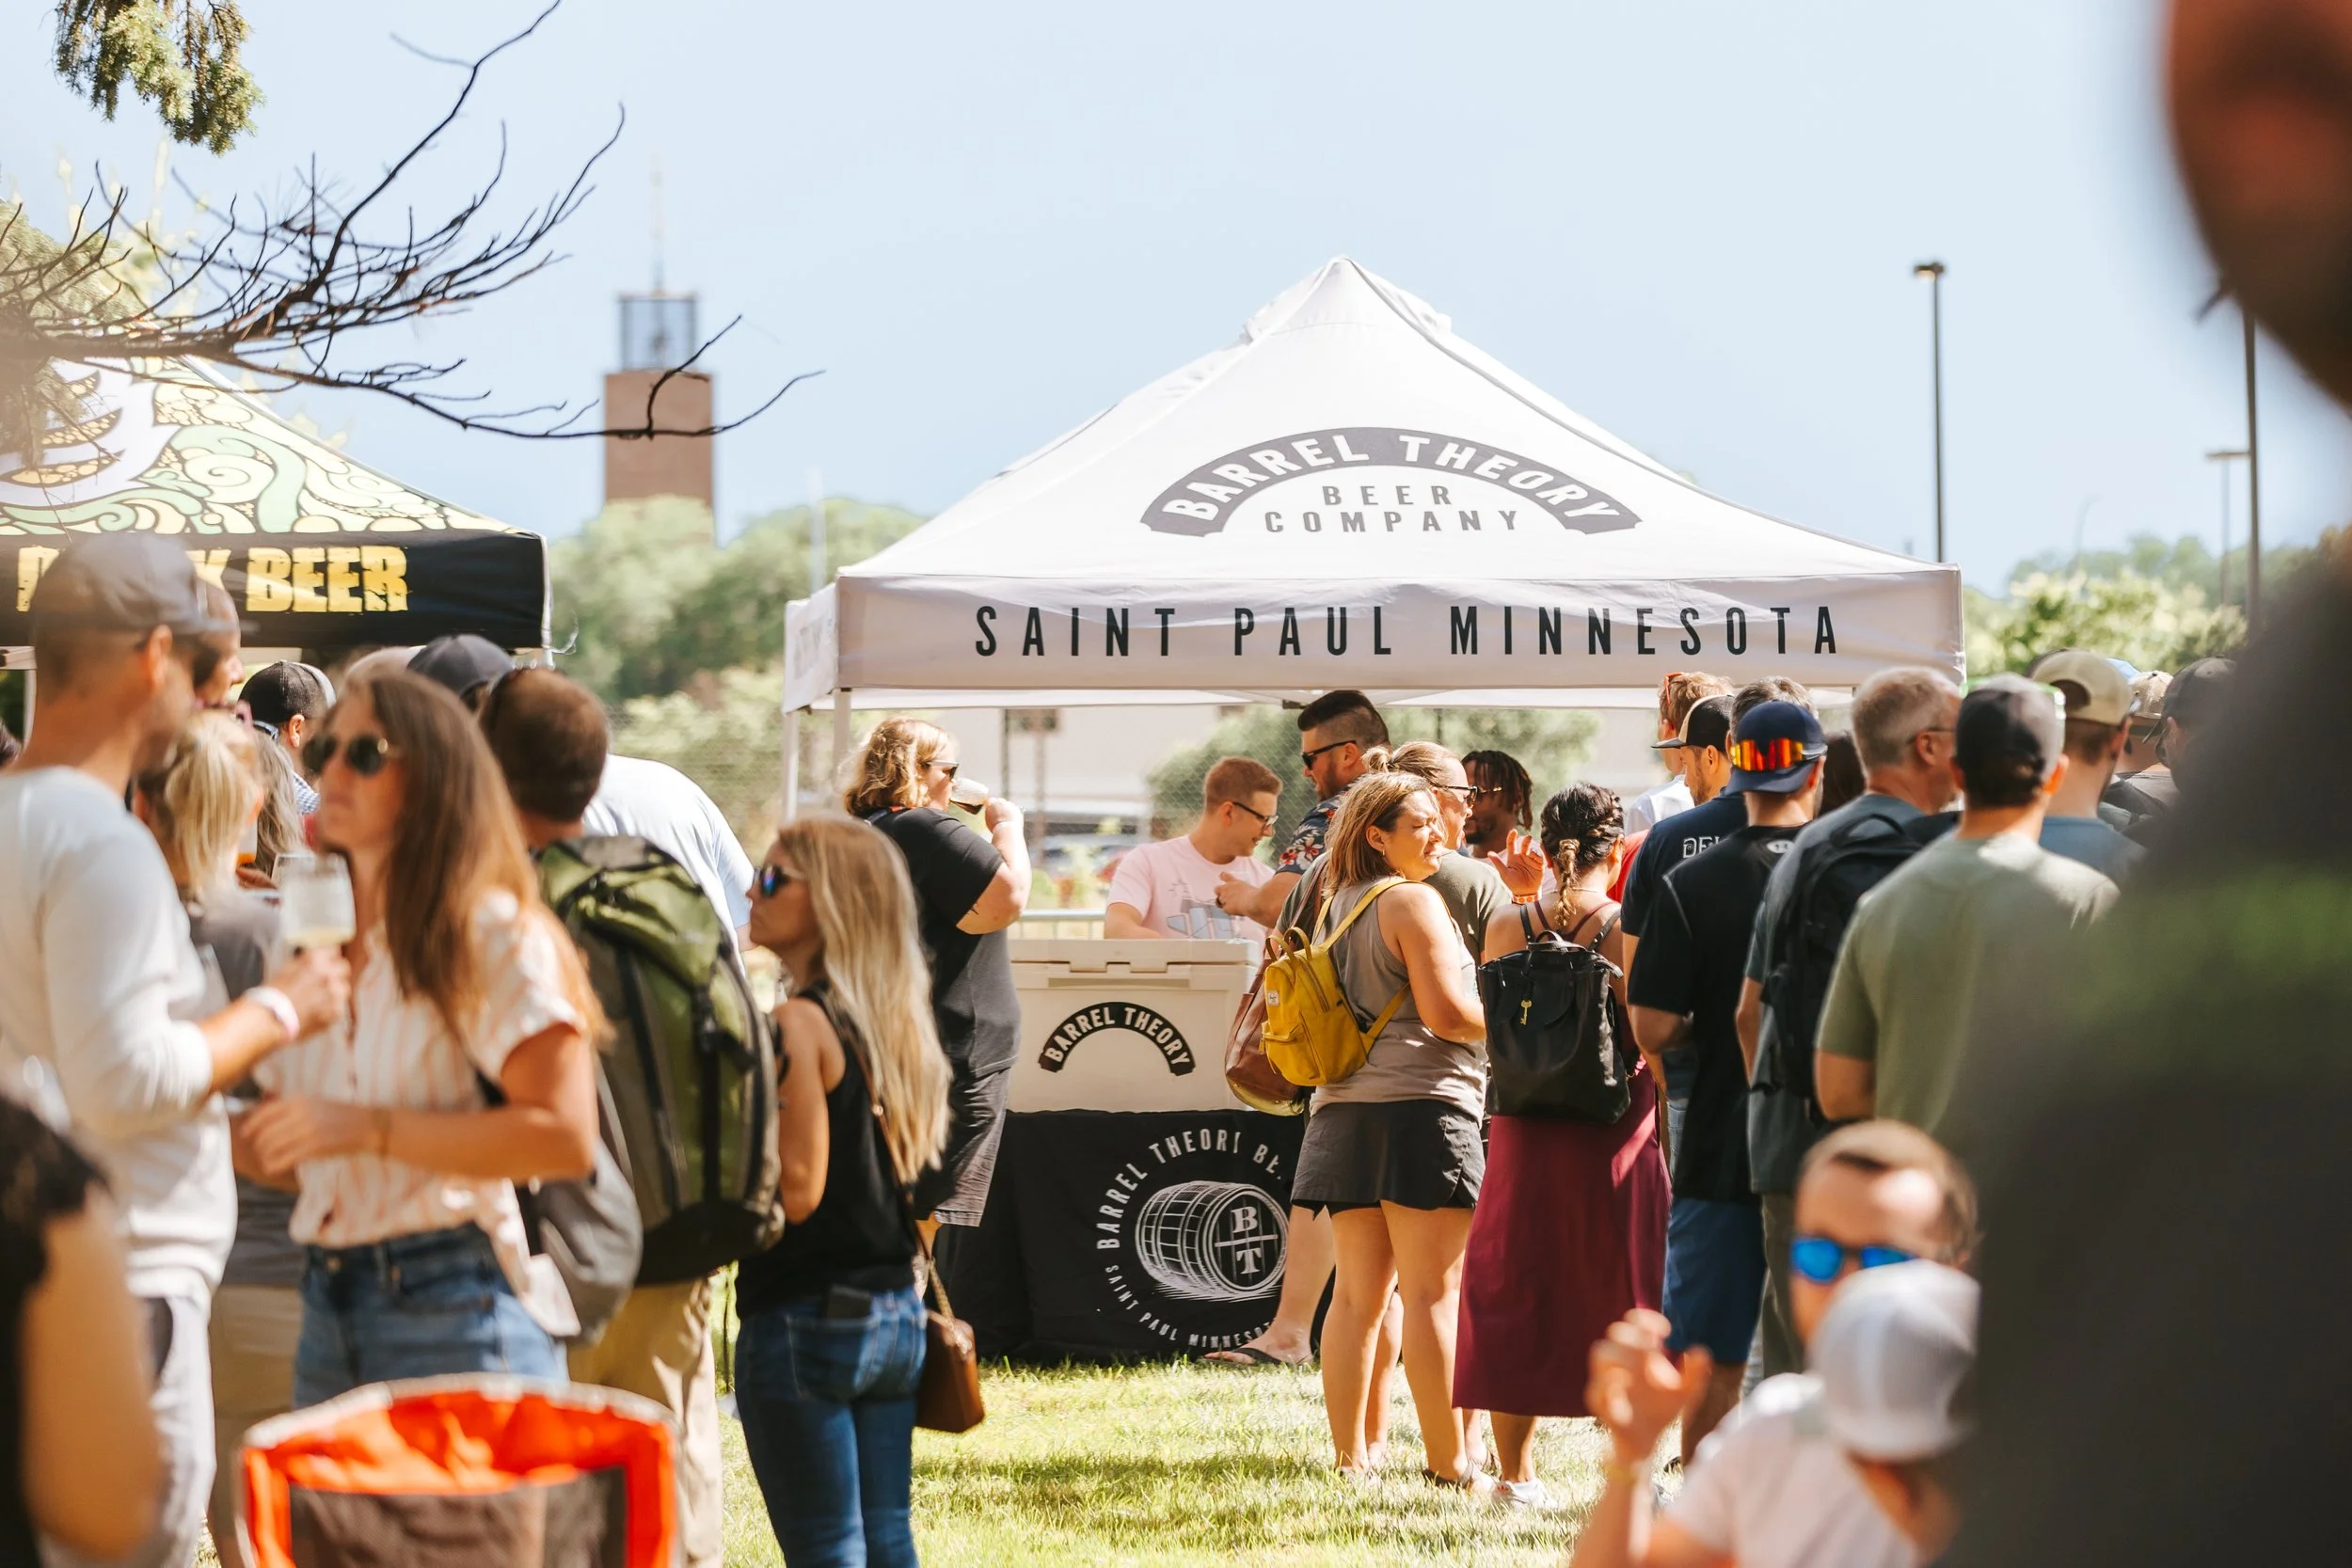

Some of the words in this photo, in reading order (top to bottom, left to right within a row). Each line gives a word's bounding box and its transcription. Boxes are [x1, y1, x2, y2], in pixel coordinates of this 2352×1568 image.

[1162, 434, 1370, 521] BARREL
[1398, 435, 1620, 521] THEORY
[1322, 484, 1453, 507] BEER
[1264, 510, 1518, 533] COMPANY
[246, 545, 410, 613] BEER
[975, 605, 1176, 657] SAINT
[1233, 606, 1392, 657] PAUL
[1450, 605, 1837, 656] MINNESOTA
[1044, 1006, 1116, 1063] BARREL
[1124, 1006, 1191, 1065] THEORY
[1096, 1163, 1148, 1249] BARREL
[1104, 1264, 1140, 1310] SAINT
[1138, 1311, 1179, 1341] PAUL
[1187, 1322, 1270, 1349] MINNESO
